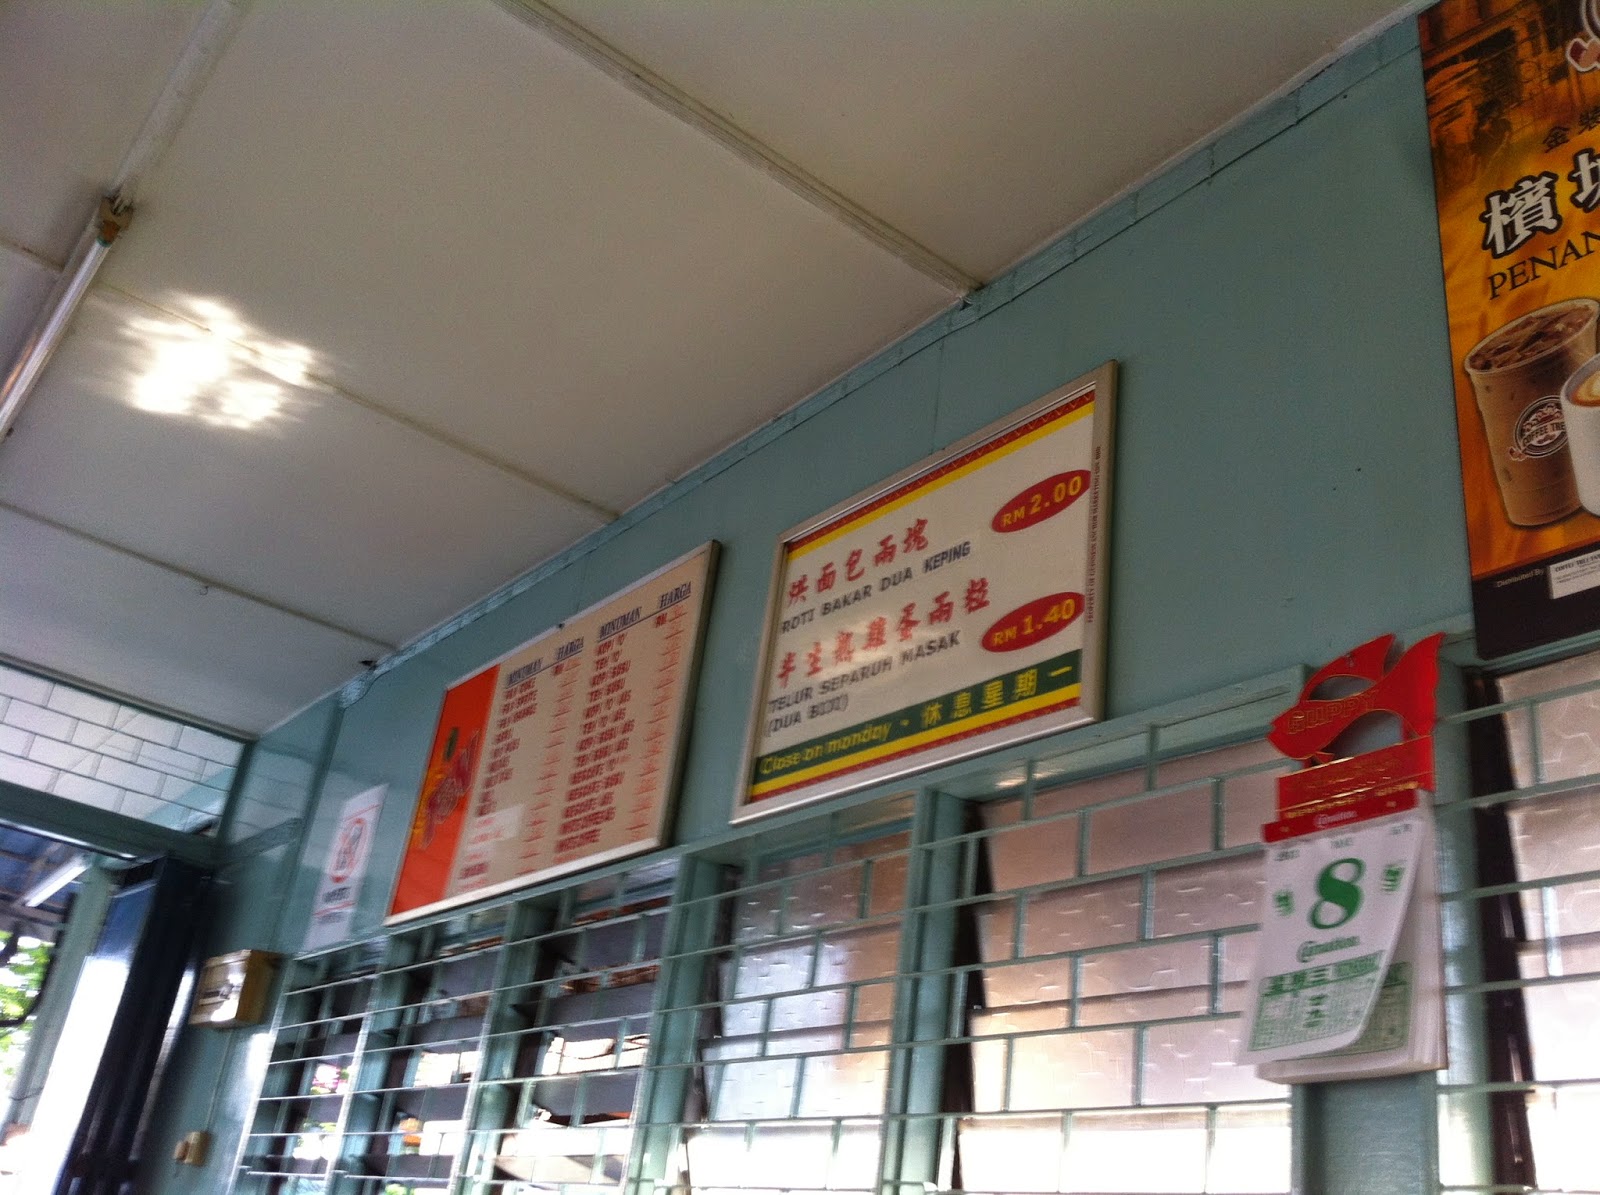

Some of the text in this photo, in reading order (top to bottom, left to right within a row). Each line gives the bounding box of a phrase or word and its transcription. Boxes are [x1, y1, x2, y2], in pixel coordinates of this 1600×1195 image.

[1523, 425, 1548, 445] COFFEE
[1002, 475, 1083, 527] RM 2.00
[600, 609, 641, 637] MINUMAN
[660, 582, 692, 608] HARGA
[782, 541, 971, 634] ROTI BAKAR DUA KEPING
[557, 637, 584, 660] HARGA
[992, 599, 1075, 647] RM 1.40
[768, 630, 960, 714] TELUR SEPARUH MASAK
[922, 666, 1073, 727] 休息星期一
[761, 721, 893, 775] Close on monday
[766, 711, 801, 737] (DUA
[1309, 856, 1366, 931] 8
